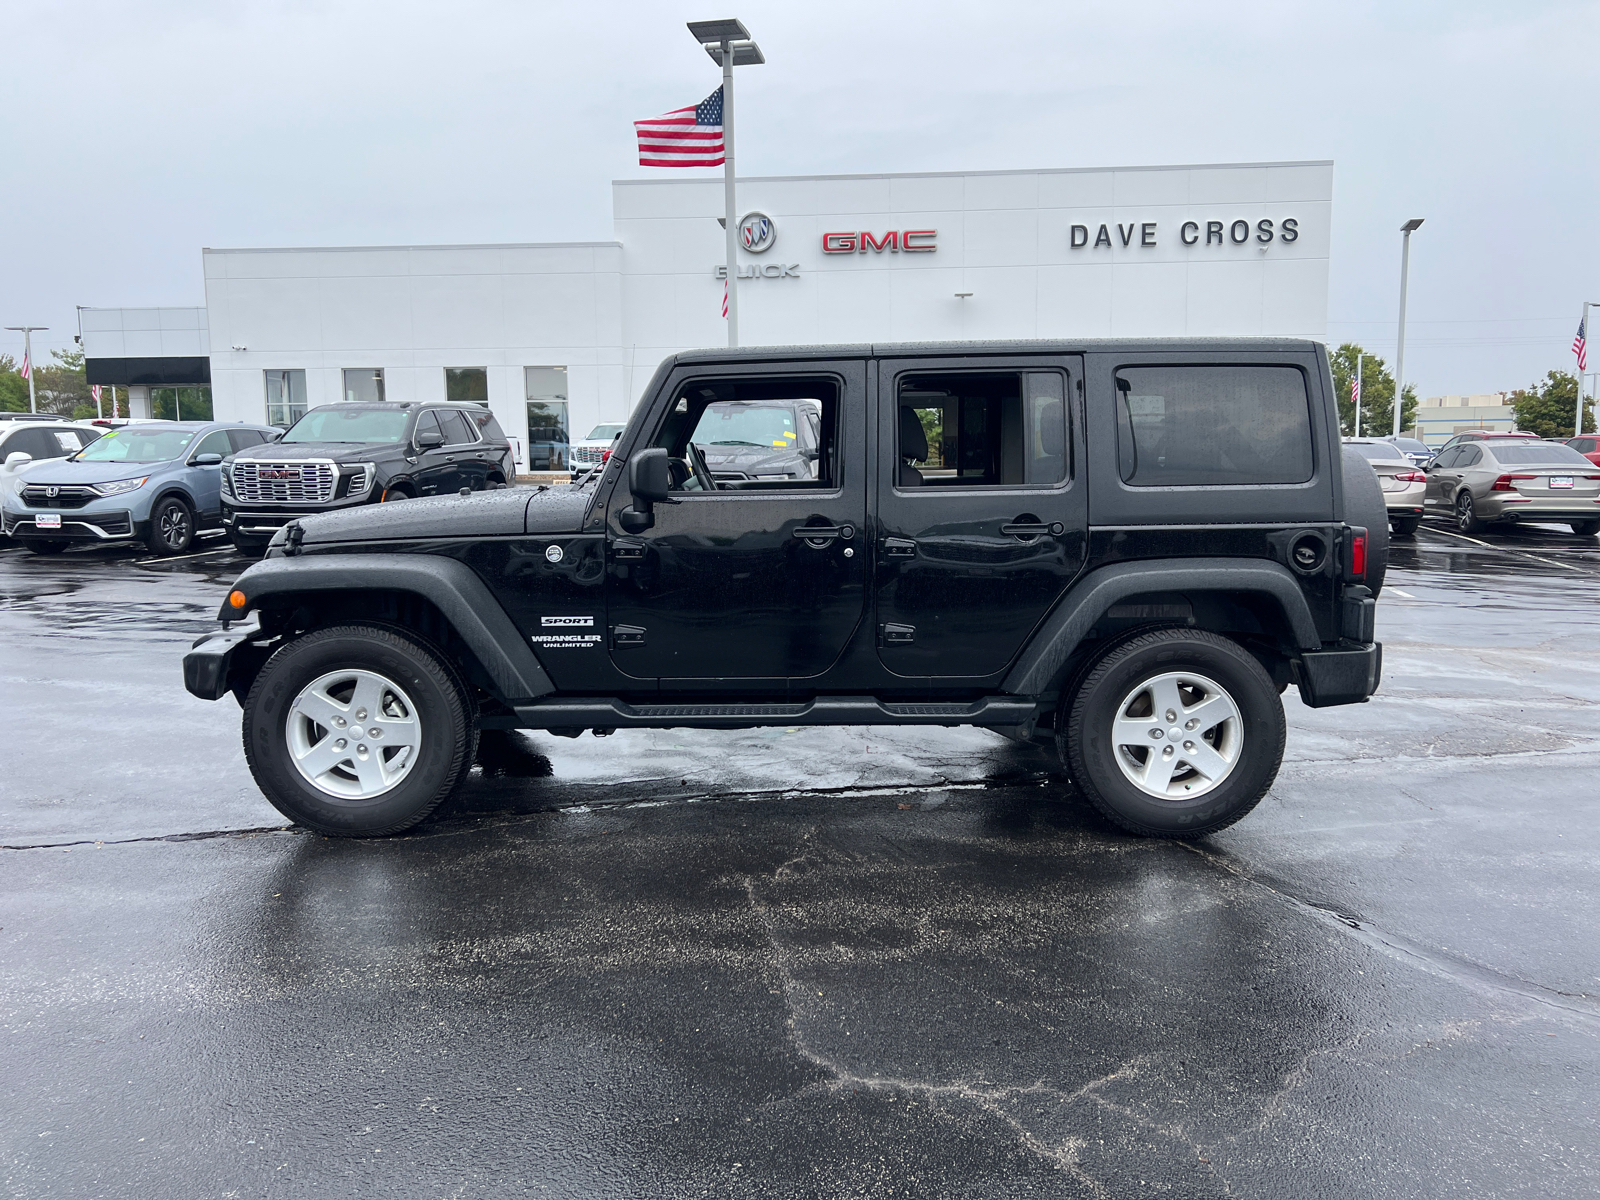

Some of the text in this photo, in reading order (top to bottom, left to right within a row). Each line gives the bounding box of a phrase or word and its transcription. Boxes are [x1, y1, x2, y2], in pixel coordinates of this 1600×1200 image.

[822, 229, 938, 254] GMC
[1070, 217, 1299, 249] DAVE CROSS
[714, 263, 800, 279] BUICK
[258, 470, 300, 479] GMC
